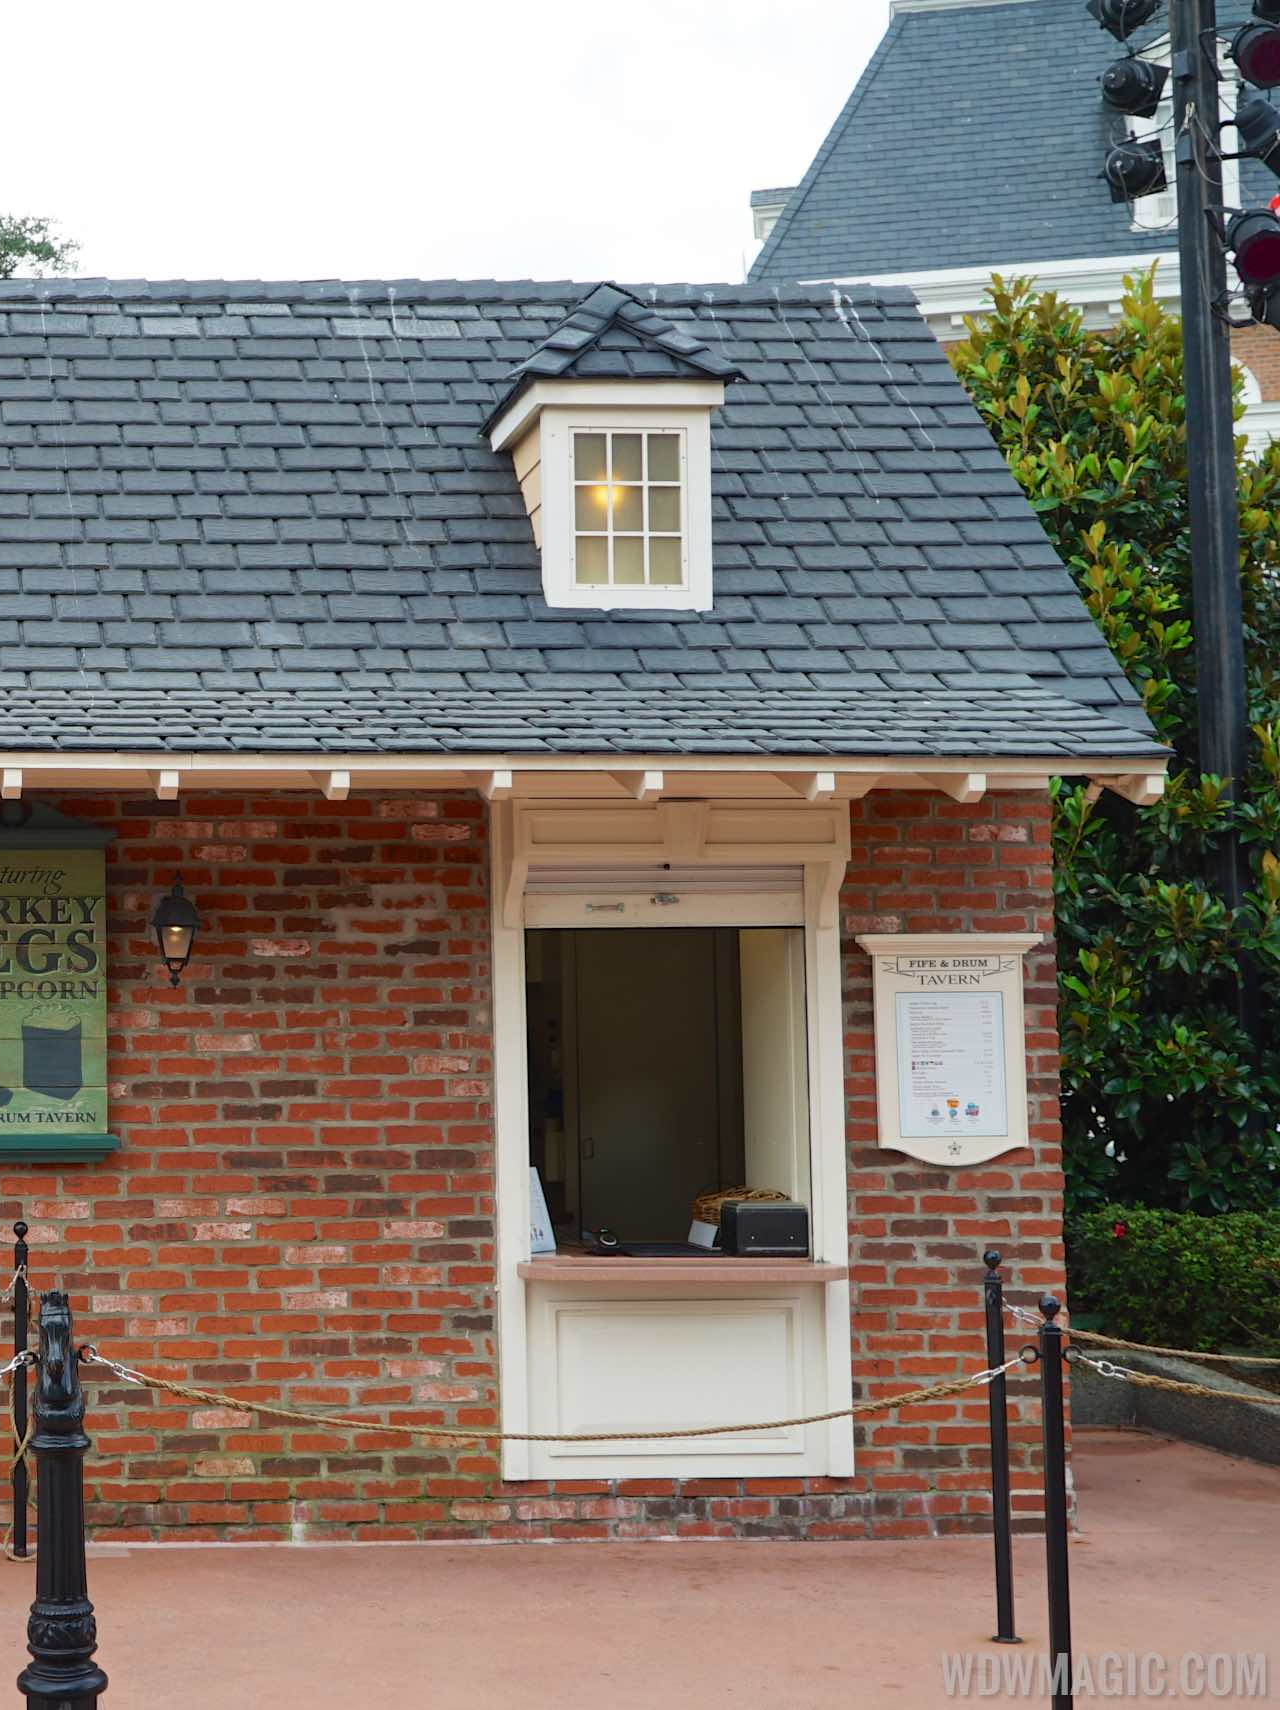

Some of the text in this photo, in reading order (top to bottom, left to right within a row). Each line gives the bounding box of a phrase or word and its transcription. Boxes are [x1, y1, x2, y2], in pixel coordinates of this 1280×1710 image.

[909, 959, 988, 968] FIFE & DRUM
[916, 974, 981, 985] TAVERN
[35, 1112, 96, 1124] TAVERN
